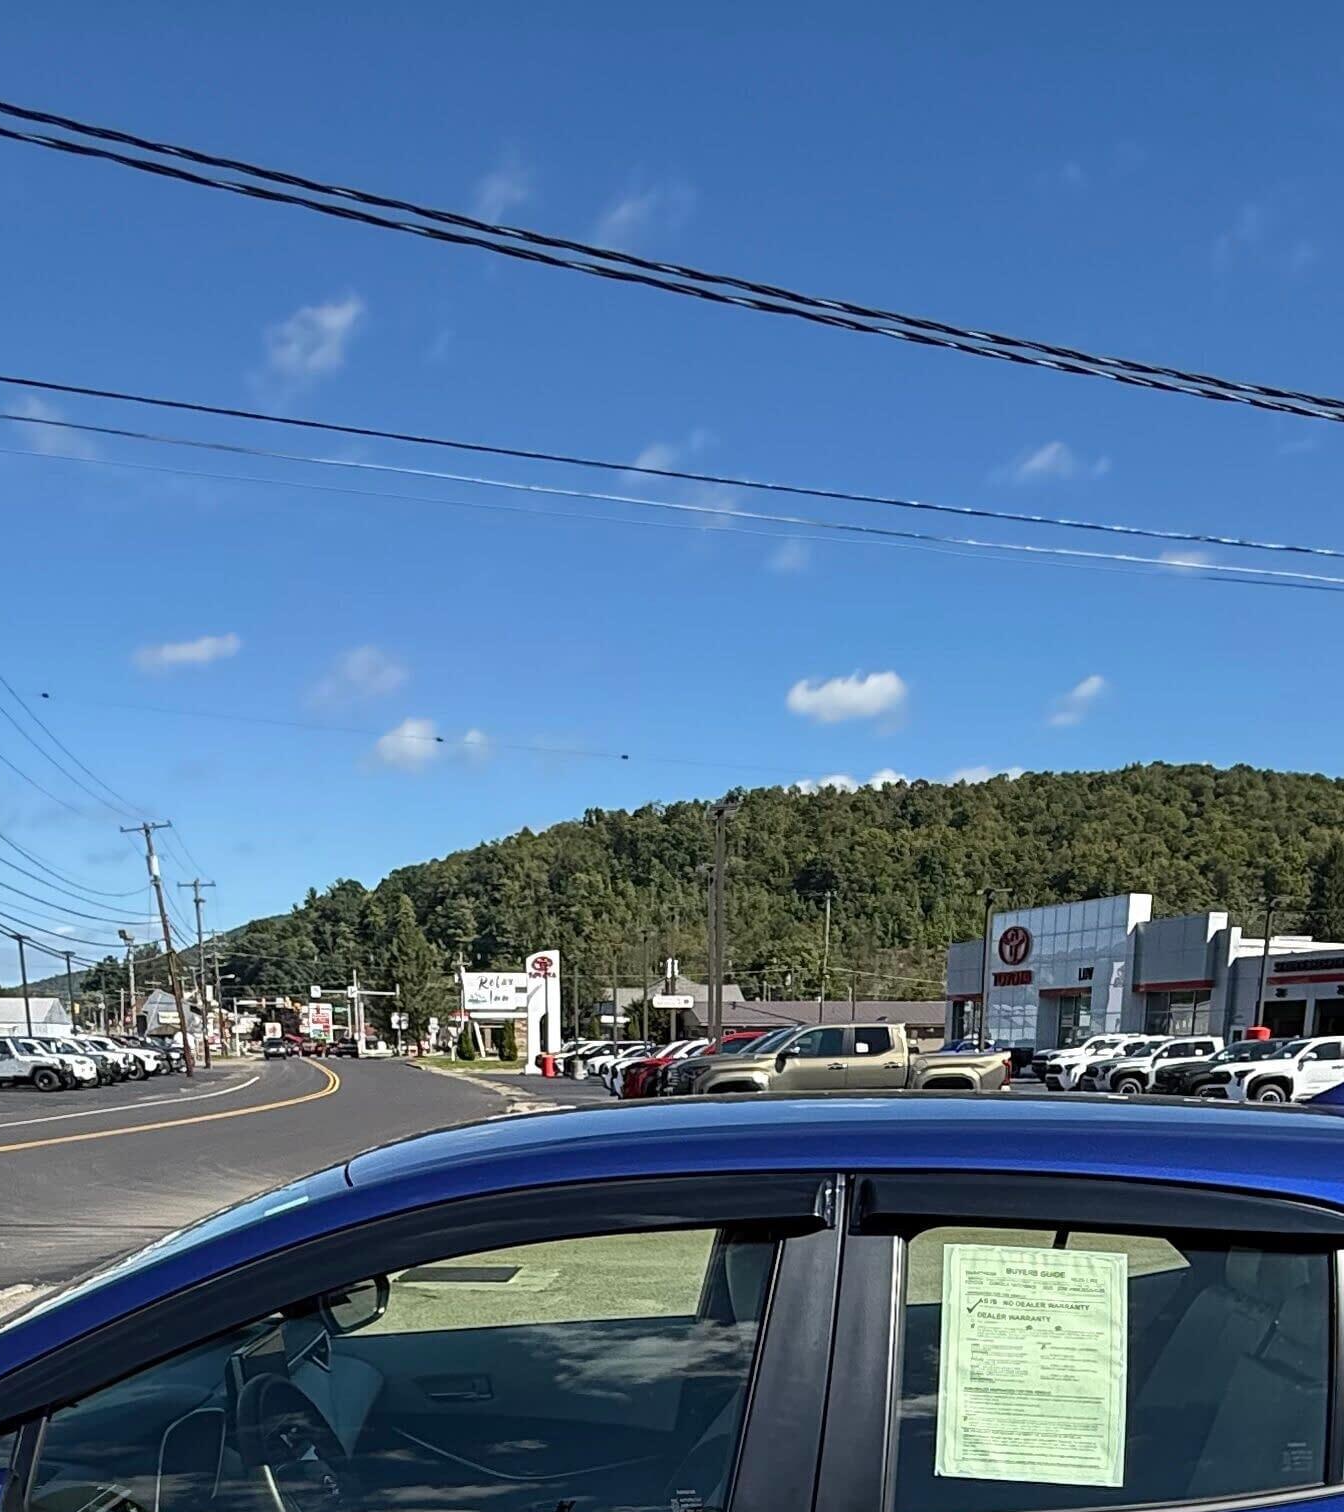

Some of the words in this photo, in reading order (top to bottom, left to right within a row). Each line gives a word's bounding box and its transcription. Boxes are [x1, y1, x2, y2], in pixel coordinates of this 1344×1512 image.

[1006, 1268, 1038, 1276] BUYERS
[1040, 1270, 1066, 1278] GUIDE
[977, 1312, 1006, 1320] DEALER
